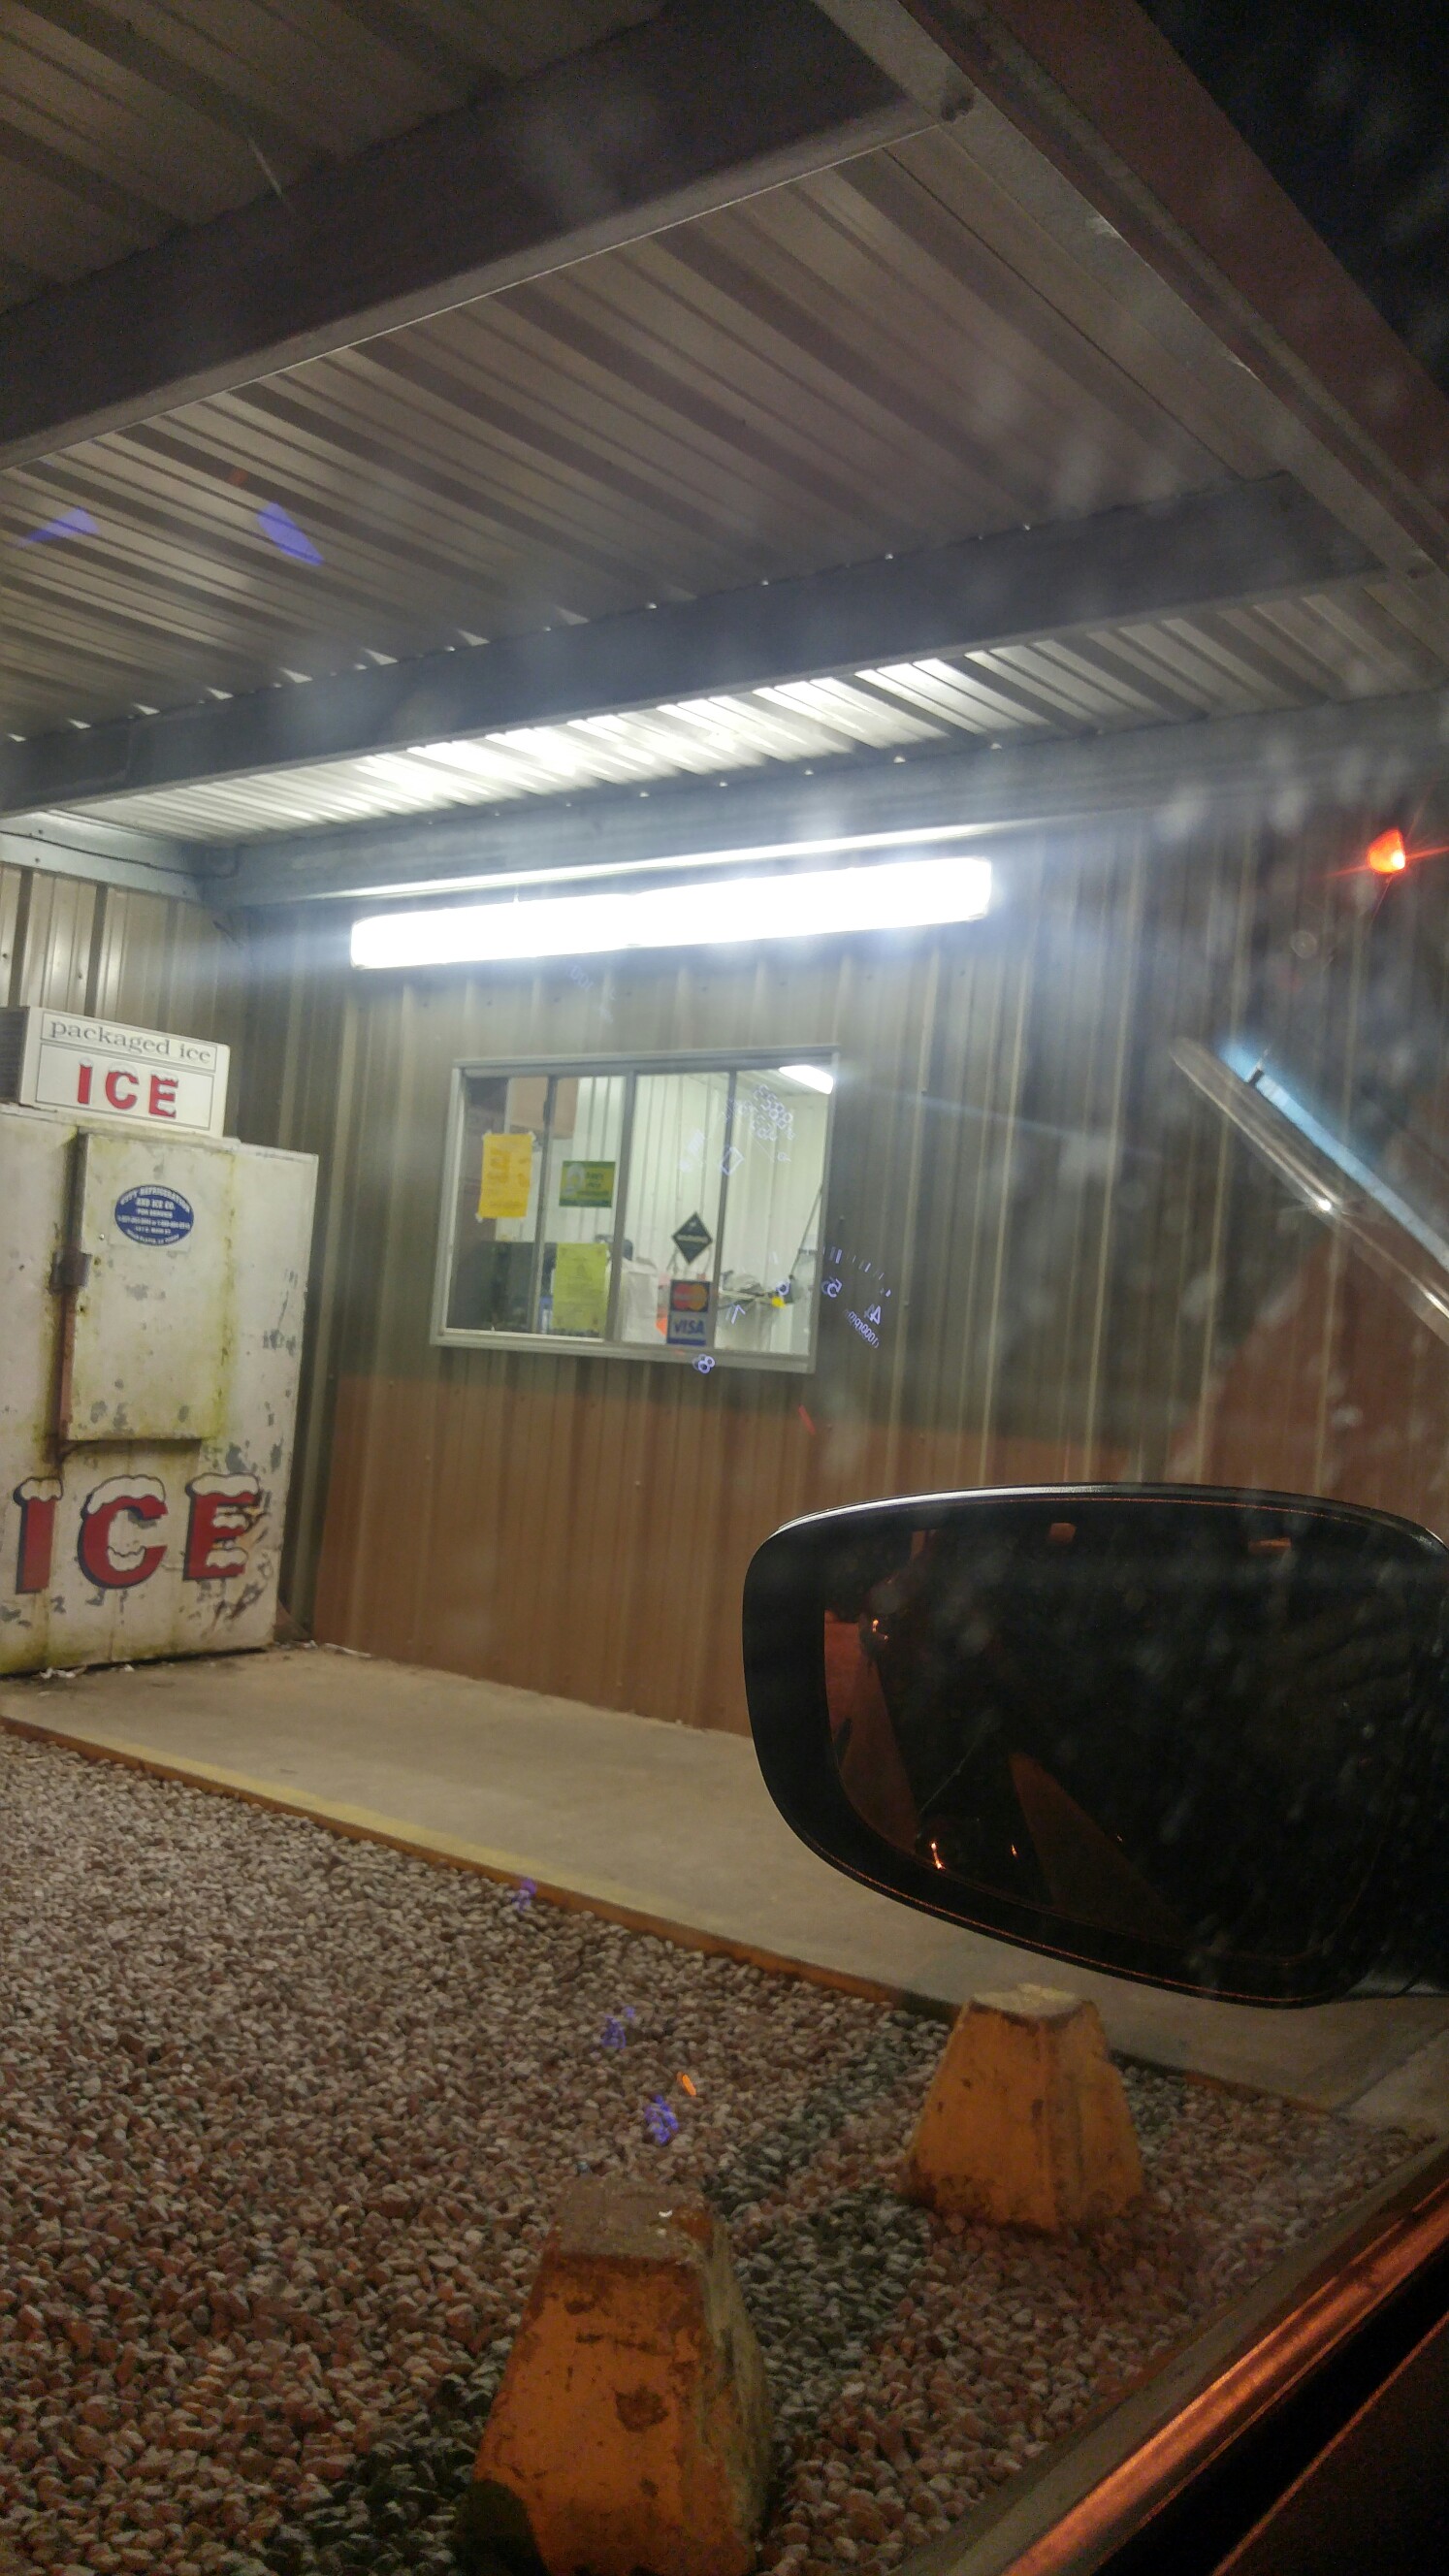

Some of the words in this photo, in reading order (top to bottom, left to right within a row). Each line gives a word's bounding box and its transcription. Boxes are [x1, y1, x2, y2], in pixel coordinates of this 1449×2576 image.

[50, 1020, 171, 1056] packaged
[179, 1043, 211, 1064] ice
[77, 1056, 179, 1118] ICE
[673, 1319, 705, 1336] VISA
[13, 1471, 262, 1594] ICE
